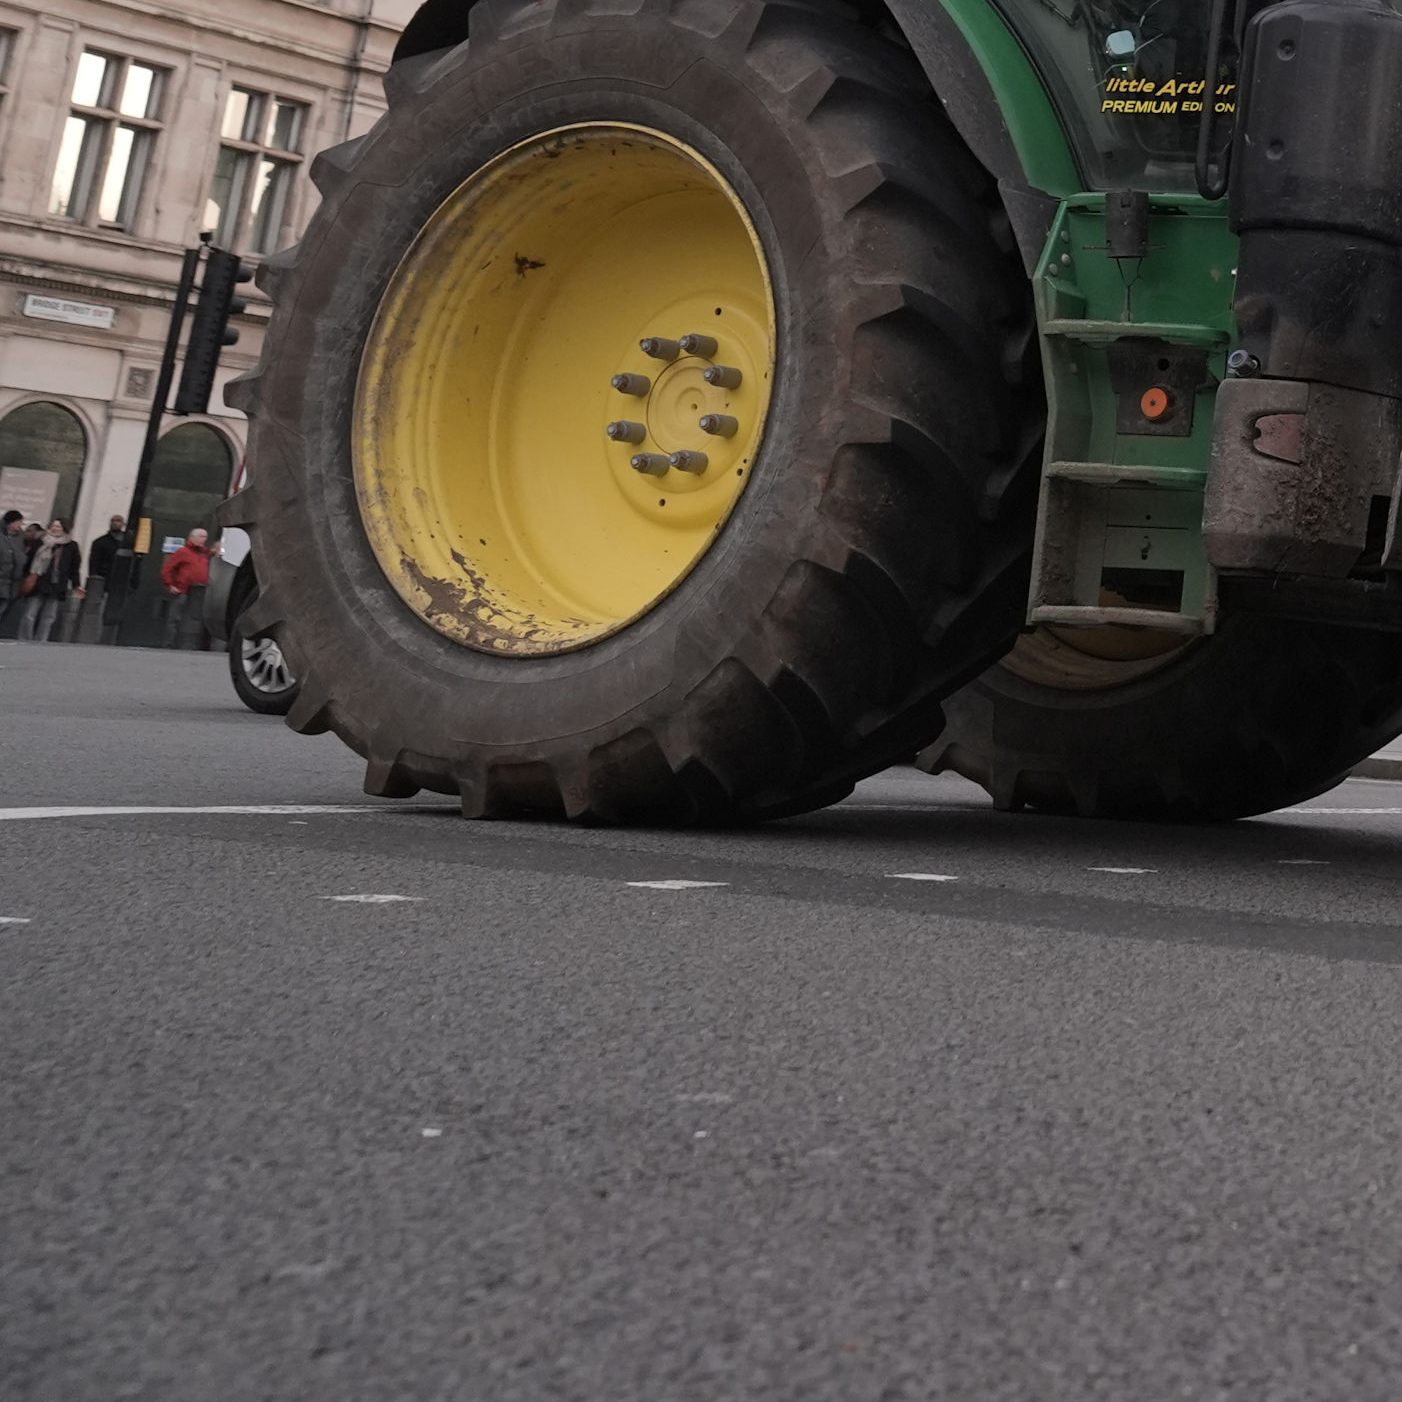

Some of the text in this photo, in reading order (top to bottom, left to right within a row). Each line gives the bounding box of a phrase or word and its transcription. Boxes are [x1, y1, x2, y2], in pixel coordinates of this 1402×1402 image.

[1105, 77, 1155, 93] little
[1101, 100, 1236, 114] PREMIUM EDION
